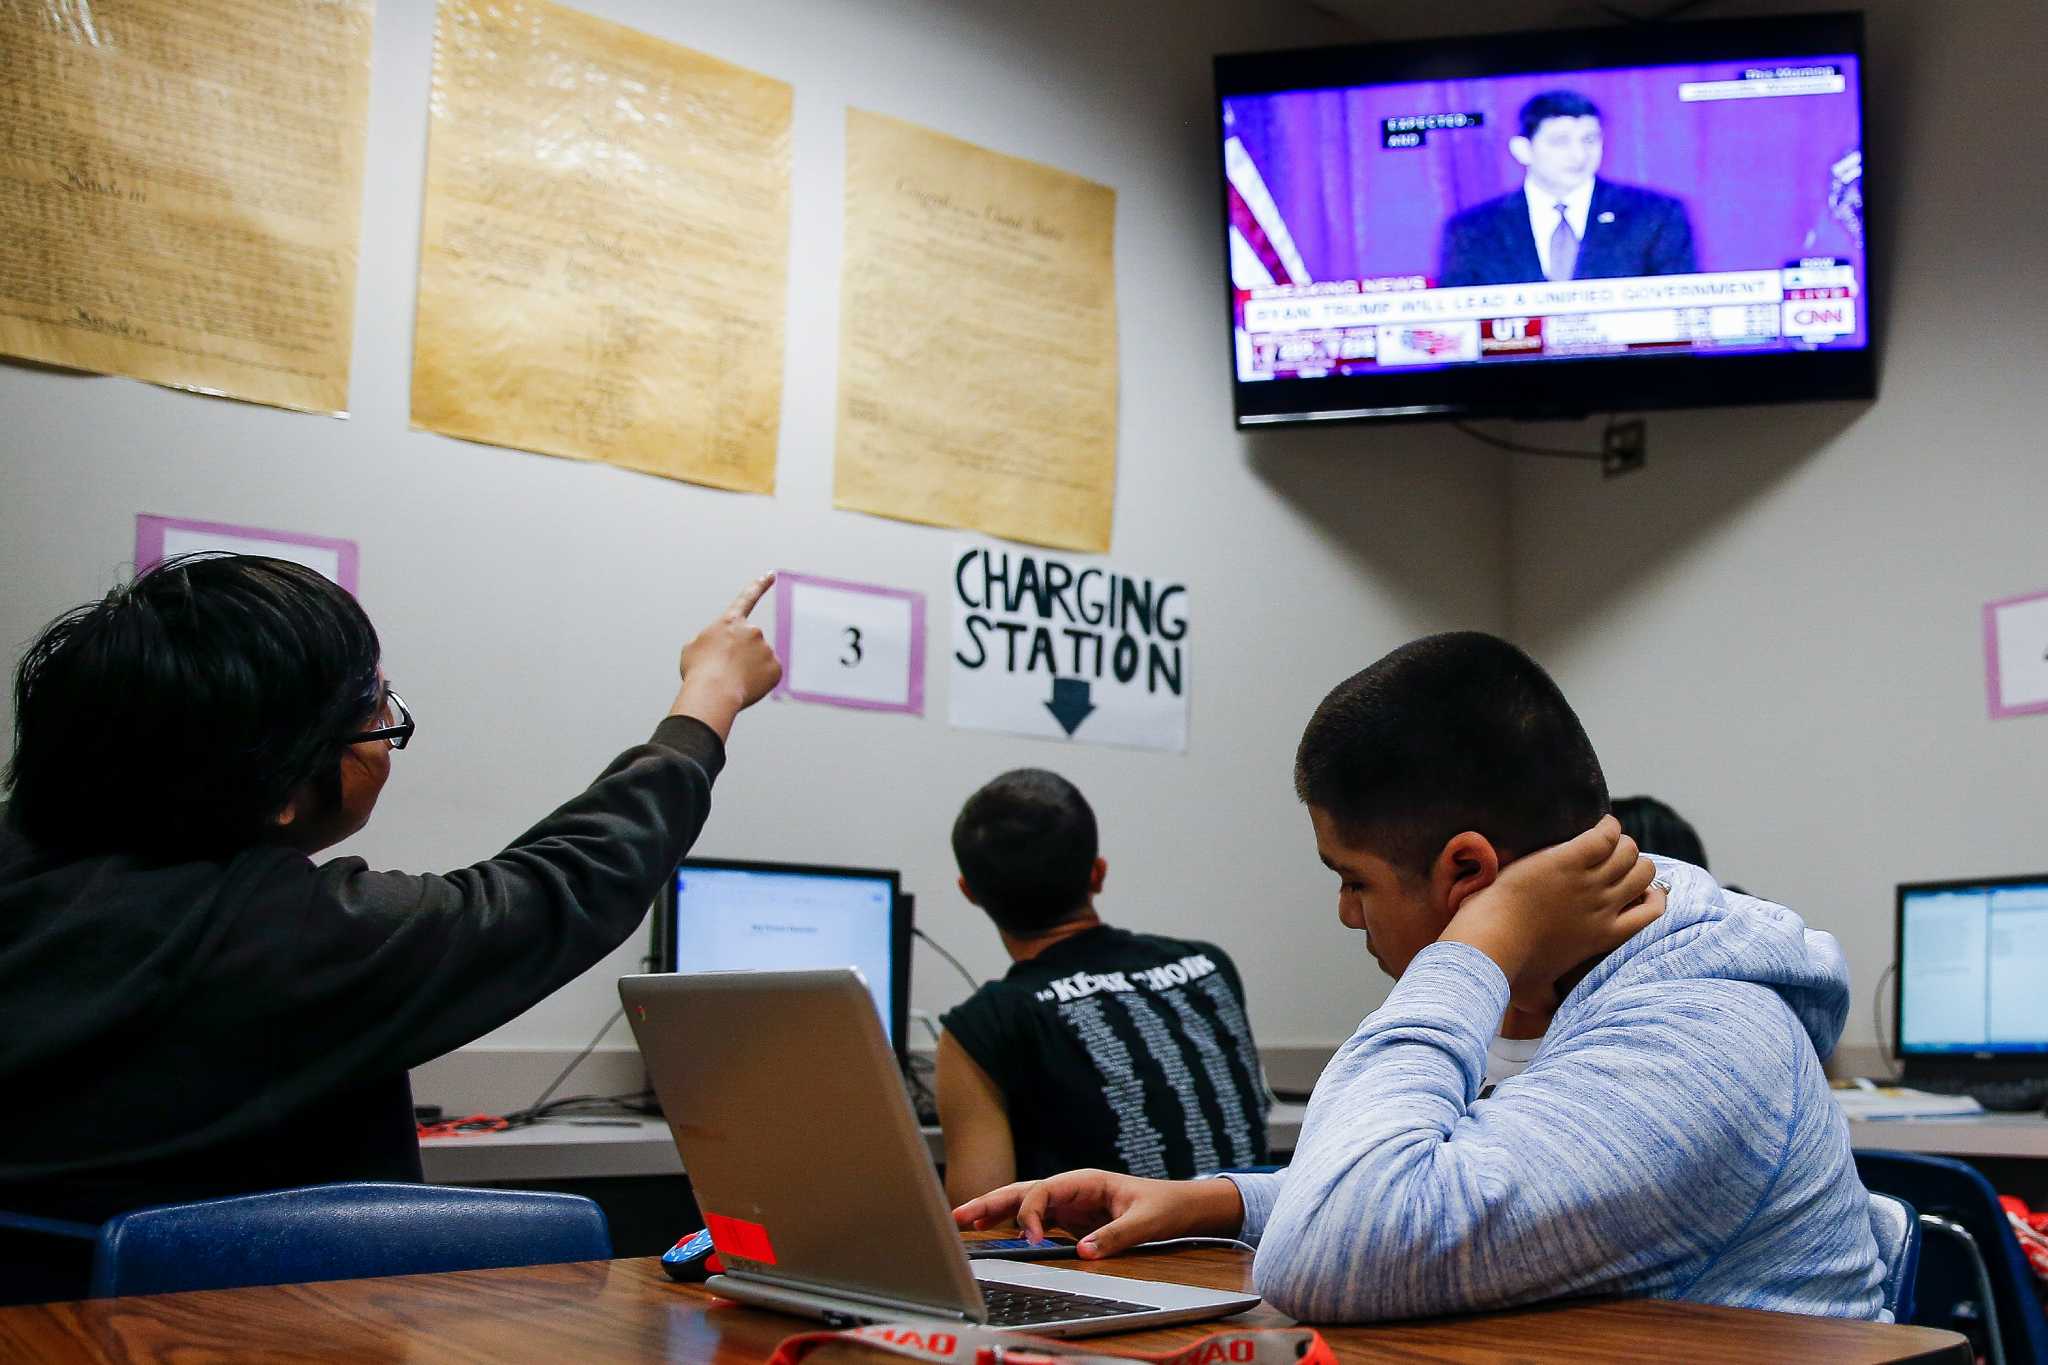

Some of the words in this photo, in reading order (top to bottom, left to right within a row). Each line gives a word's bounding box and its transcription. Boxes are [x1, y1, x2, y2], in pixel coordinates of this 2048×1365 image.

[1323, 301, 1391, 318] TRUMP
[1401, 298, 1445, 314] WILL
[1455, 294, 1506, 311] LEAD
[1535, 287, 1615, 304] UNIFIED
[1625, 279, 1766, 300] GOVERNMENT
[1794, 308, 1843, 326] CNN
[1491, 317, 1531, 341] UT
[954, 548, 1189, 642] CHARGING
[839, 625, 864, 668] 3
[954, 614, 1182, 697] STATION
